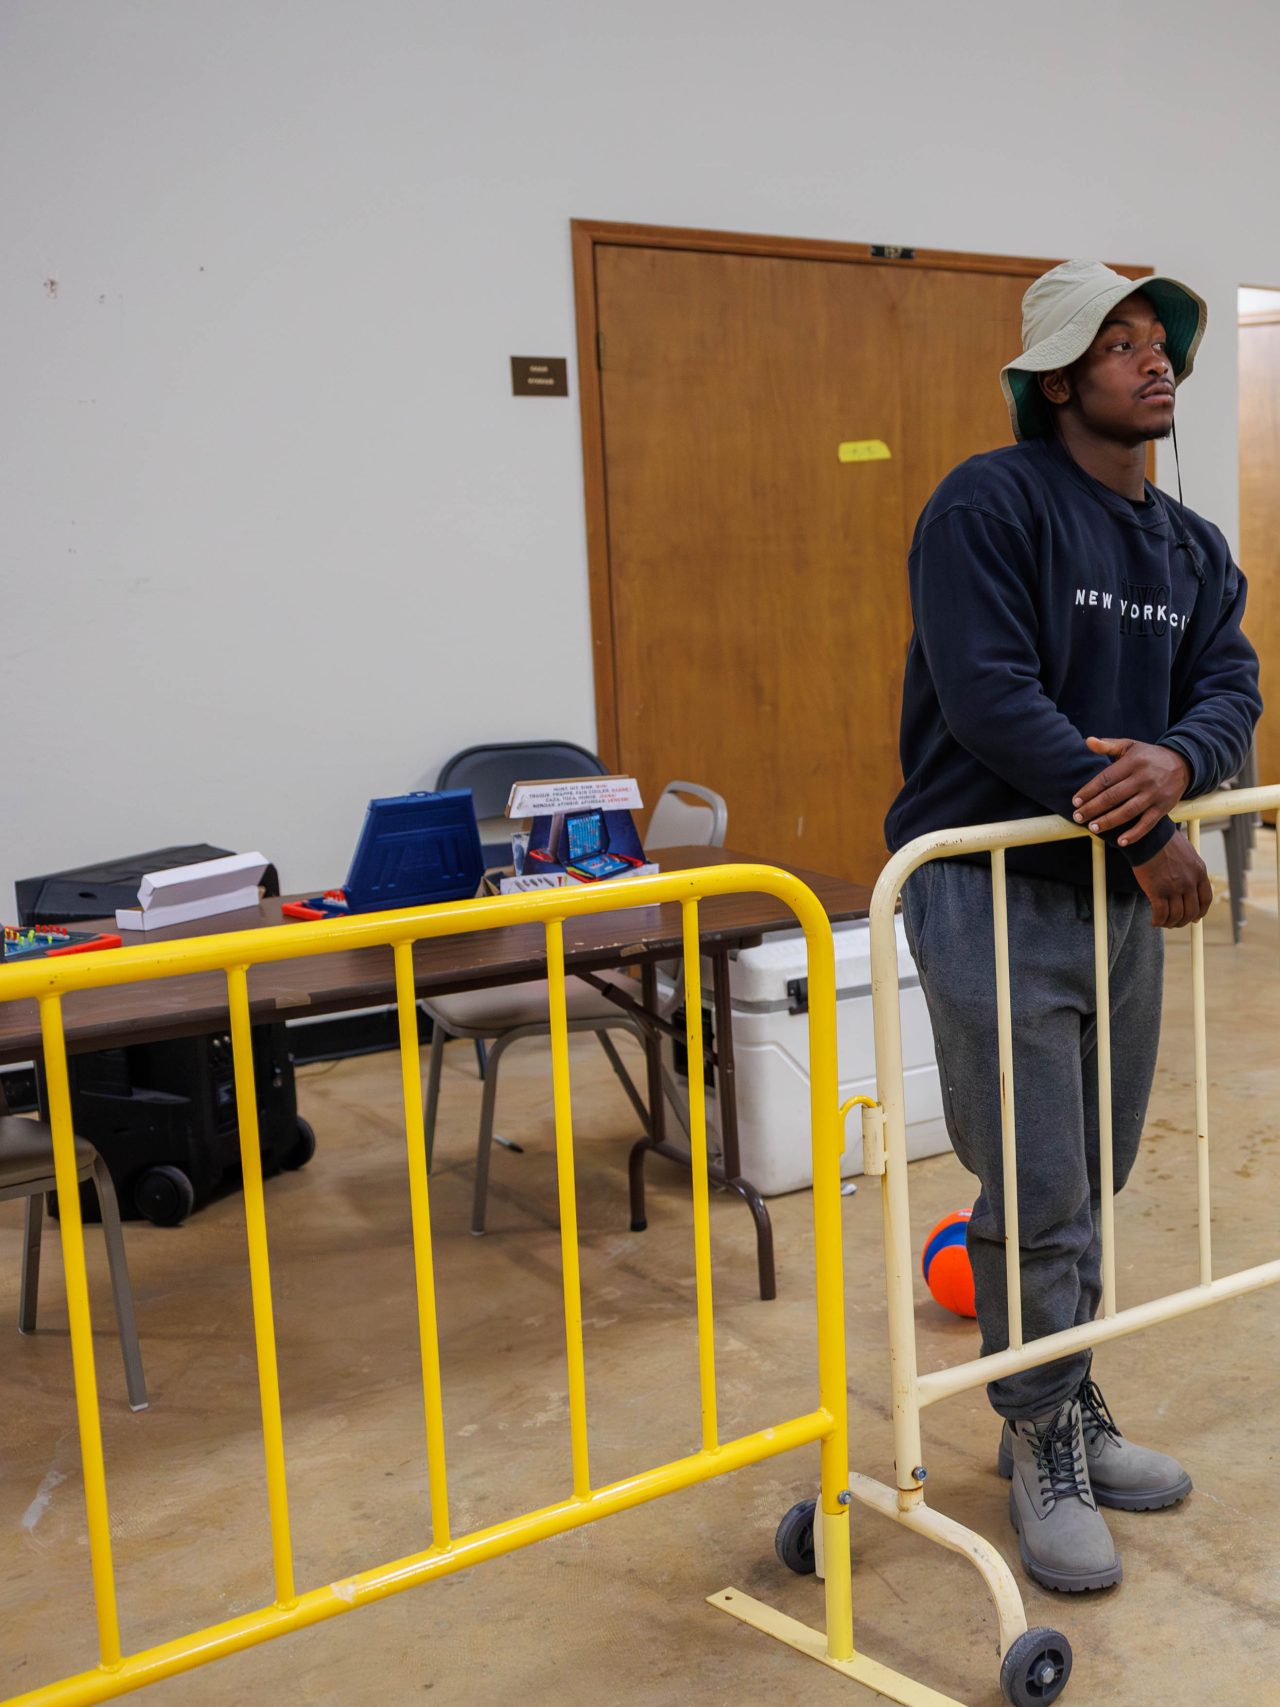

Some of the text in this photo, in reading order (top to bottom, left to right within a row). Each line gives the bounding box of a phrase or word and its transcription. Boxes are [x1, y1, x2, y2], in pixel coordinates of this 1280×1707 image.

[1075, 589, 1190, 631] NEW YORK CI
